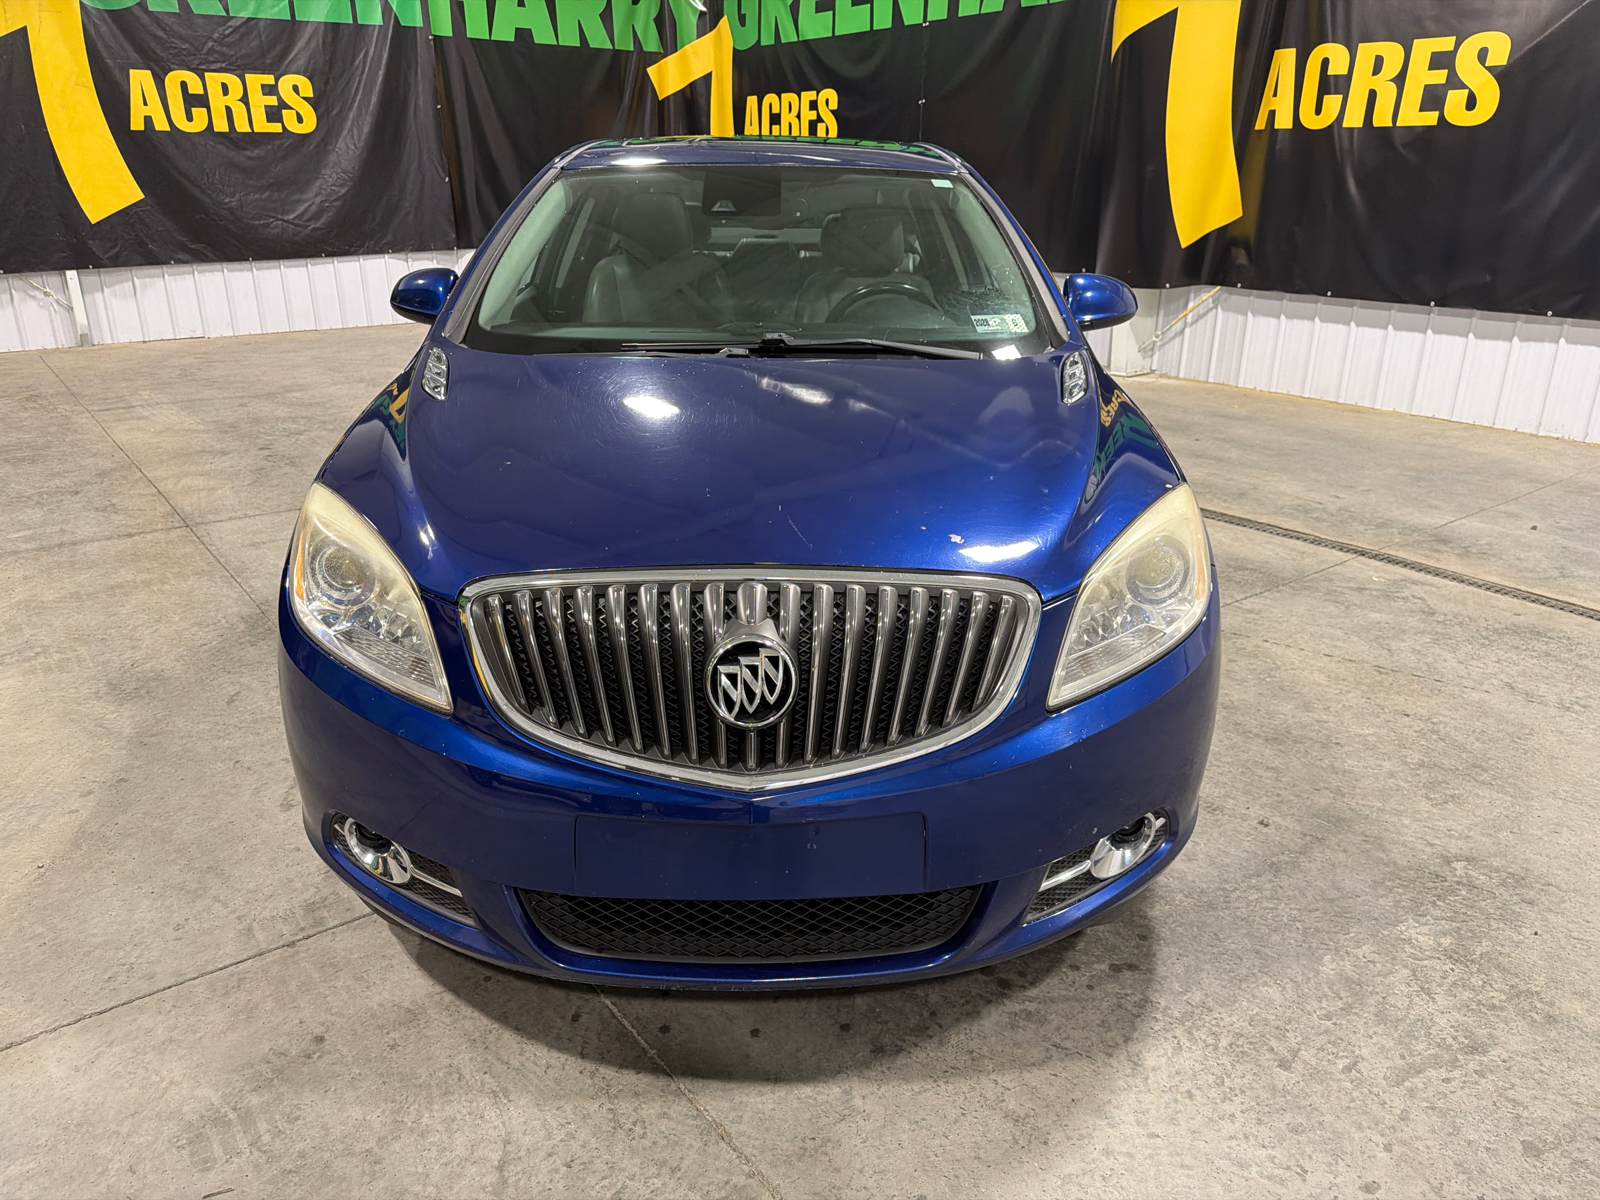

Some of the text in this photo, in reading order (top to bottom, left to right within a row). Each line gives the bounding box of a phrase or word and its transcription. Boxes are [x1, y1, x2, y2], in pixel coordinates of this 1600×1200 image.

[0, 0, 318, 224] 7 ACRES
[647, 15, 838, 138] 7 ACRES
[1111, 0, 1512, 249] 7 ACRES
